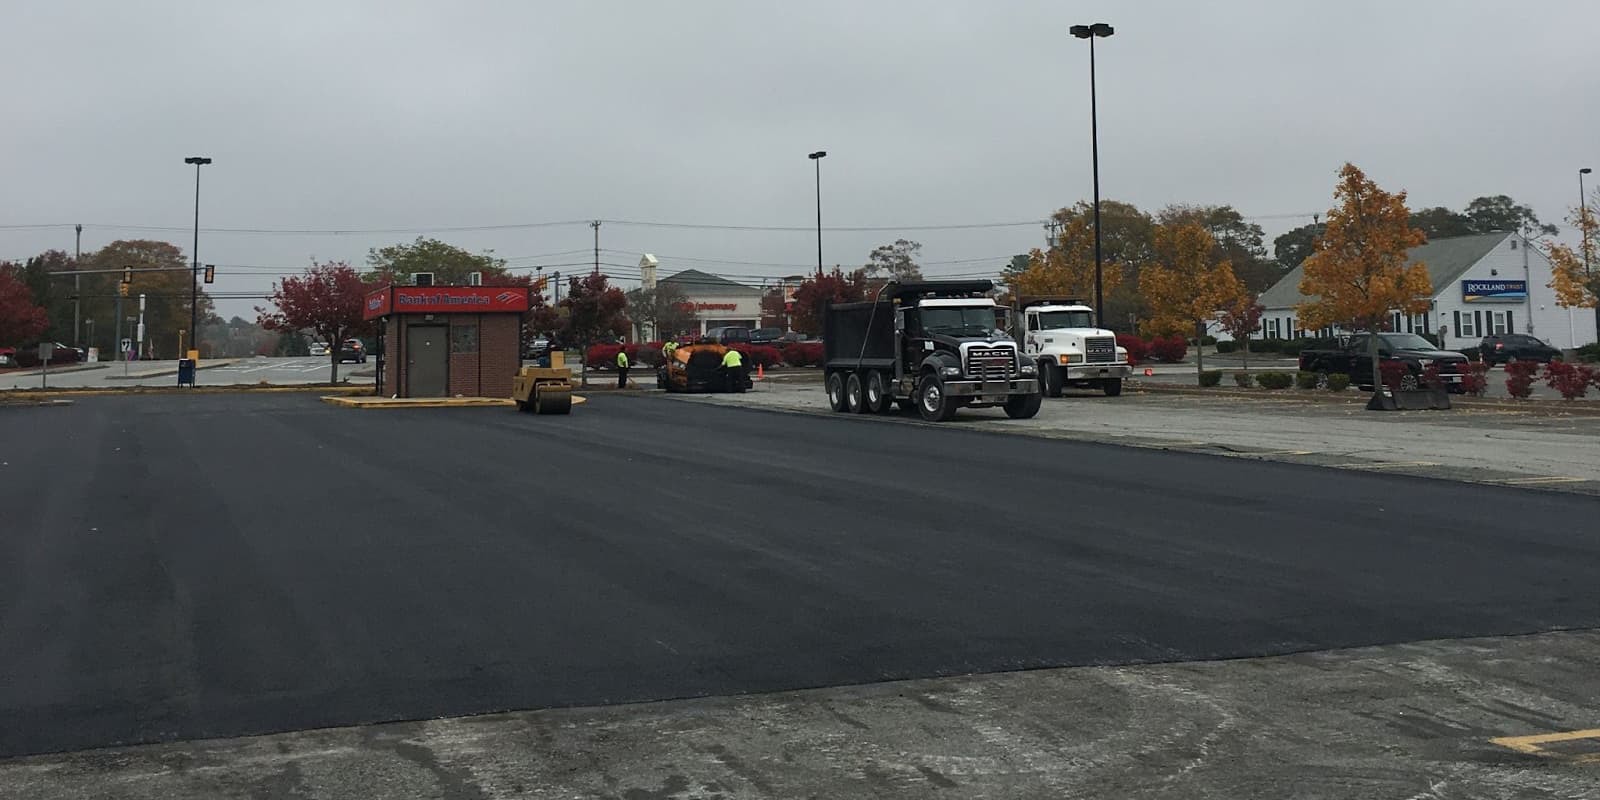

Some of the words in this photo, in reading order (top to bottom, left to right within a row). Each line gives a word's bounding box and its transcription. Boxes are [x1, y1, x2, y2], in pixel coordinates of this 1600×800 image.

[1468, 284, 1505, 292] ROCKLAND
[399, 293, 428, 304] Bank
[428, 293, 441, 304] of
[443, 293, 490, 304] America
